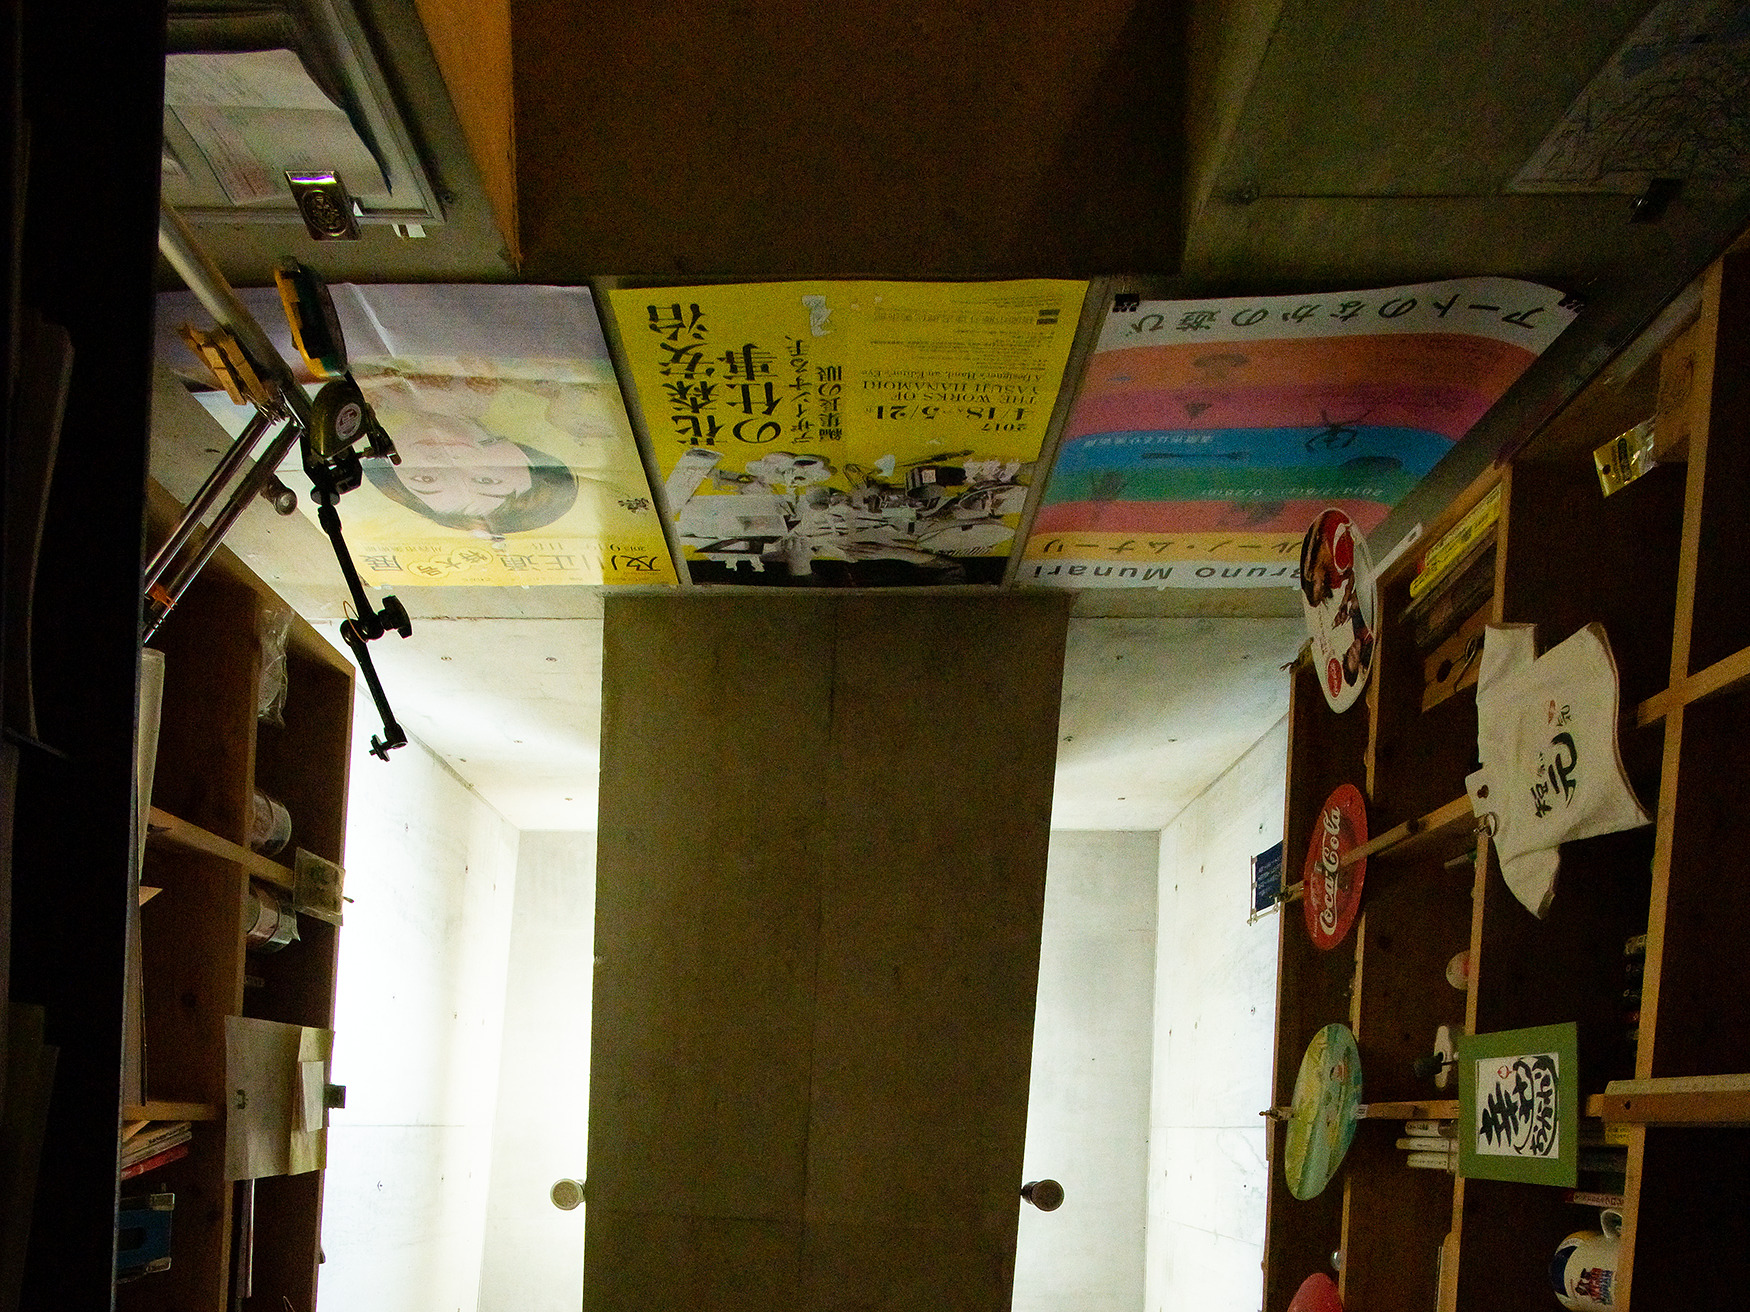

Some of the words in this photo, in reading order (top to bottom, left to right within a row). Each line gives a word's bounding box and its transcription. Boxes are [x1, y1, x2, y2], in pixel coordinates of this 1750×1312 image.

[1125, 294, 1544, 338] アートのなかの遊び
[646, 303, 728, 446] 花森安治
[716, 344, 783, 444] の仕事
[784, 335, 814, 444] デザインする手、
[862, 381, 968, 392] HANAMORI
[975, 383, 1040, 394] YASUJI
[815, 366, 843, 442] 編集長の眼
[890, 392, 916, 401] OF
[923, 392, 990, 403] WORKS
[999, 396, 1037, 404] THE
[980, 423, 1027, 432] 2017
[1043, 539, 1303, 555] ルーノ・ムナーリ
[1033, 564, 1174, 581] Munari
[1319, 806, 1341, 936] Coca-Cola
